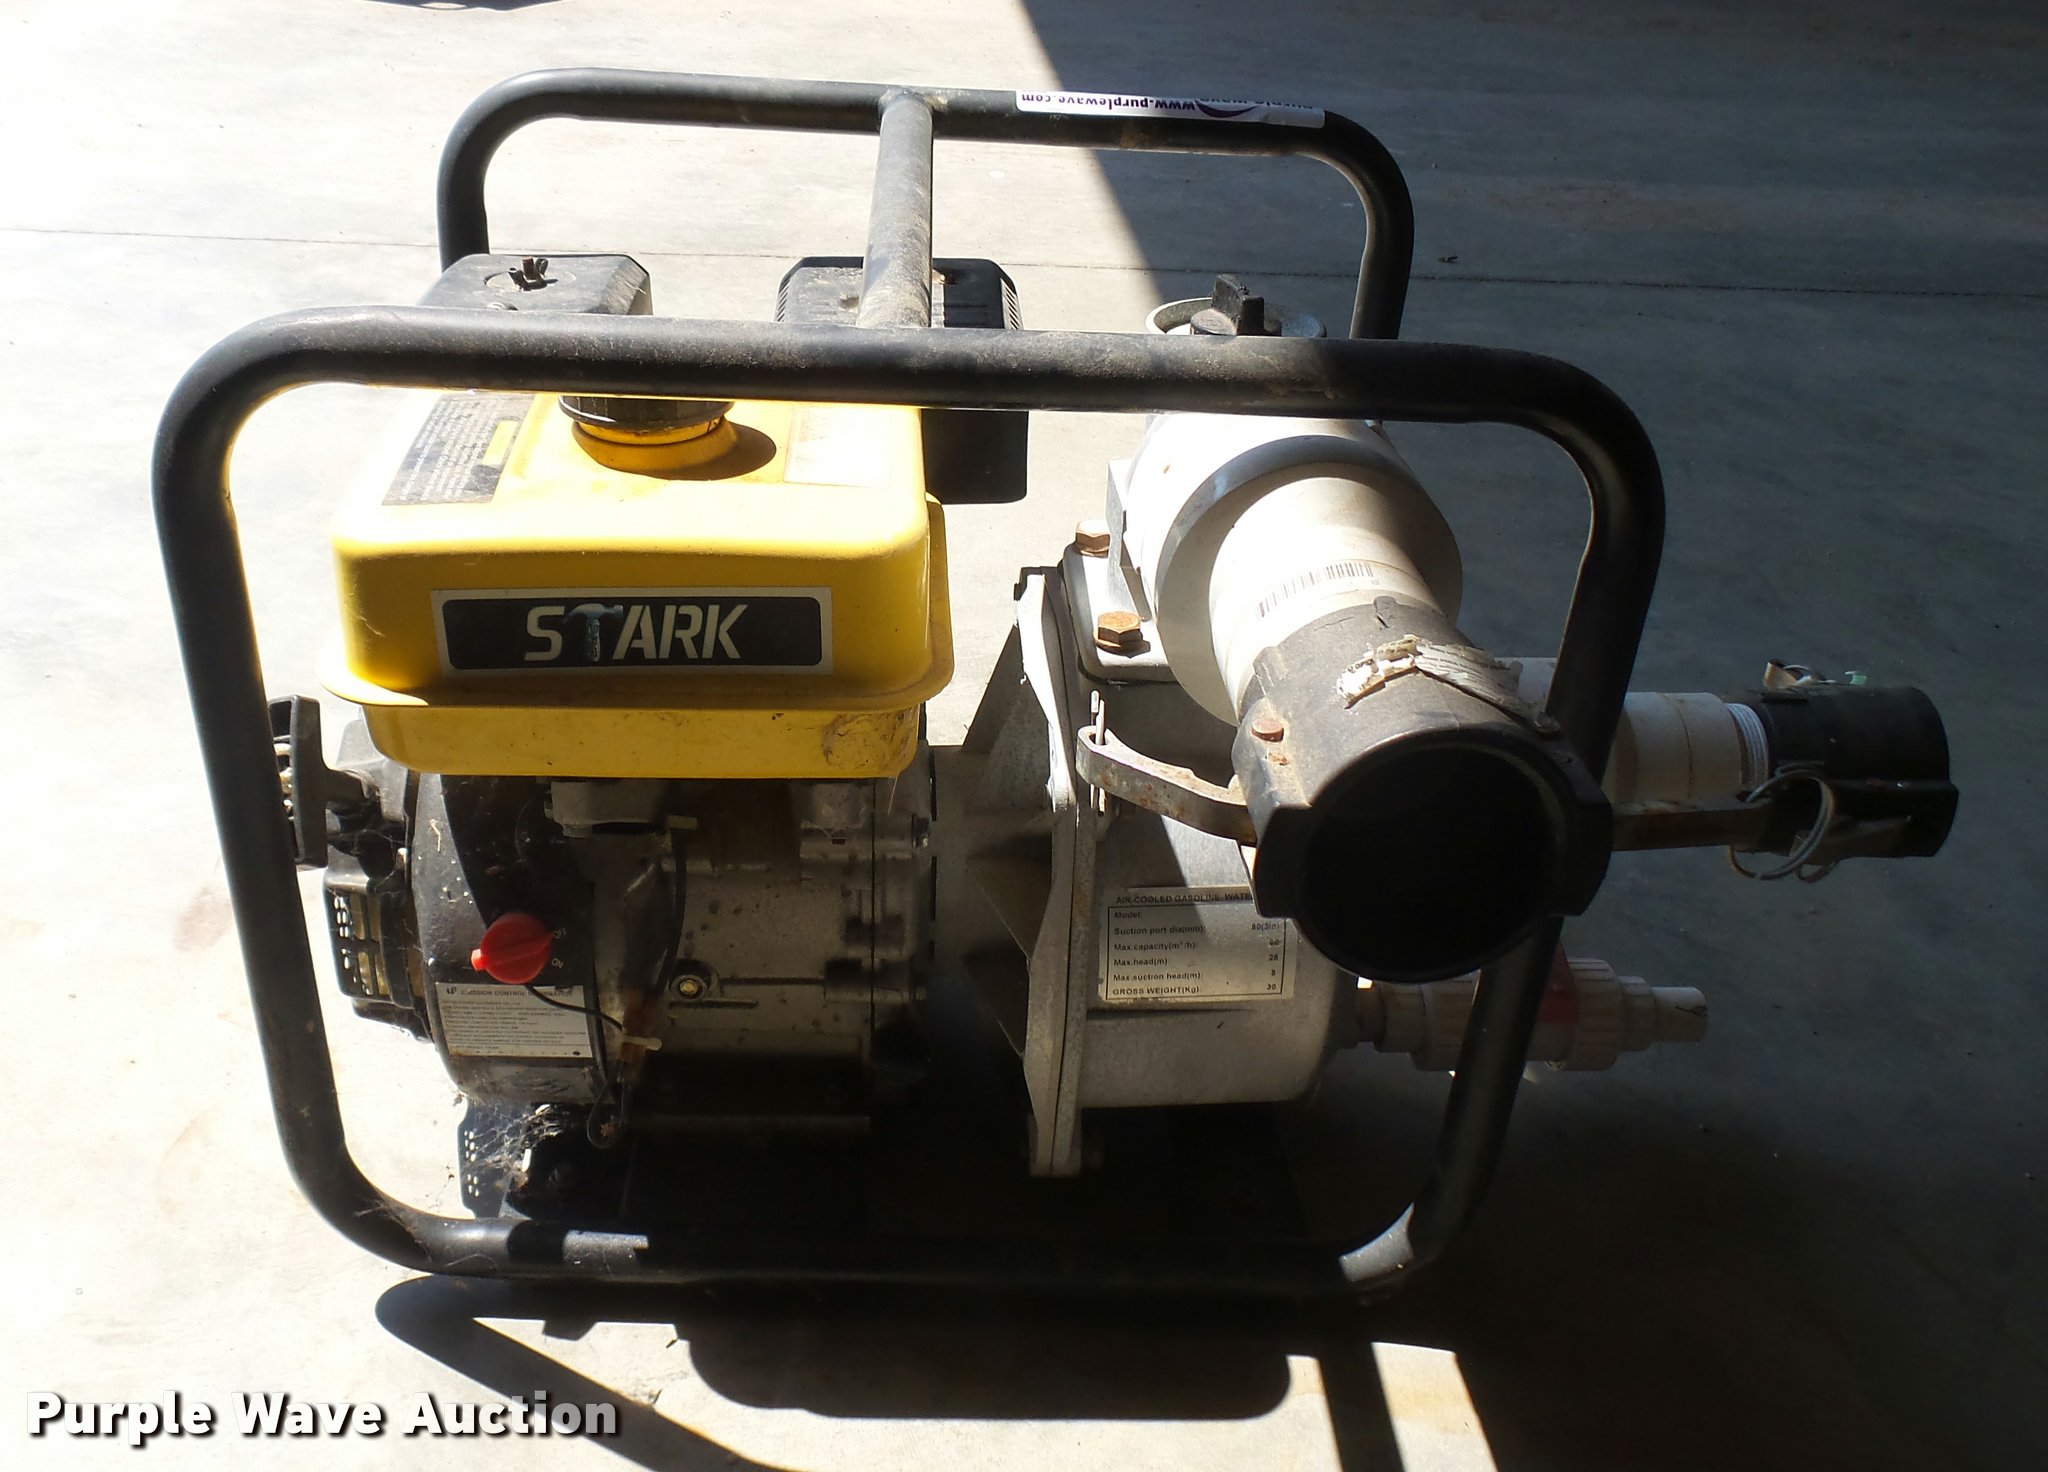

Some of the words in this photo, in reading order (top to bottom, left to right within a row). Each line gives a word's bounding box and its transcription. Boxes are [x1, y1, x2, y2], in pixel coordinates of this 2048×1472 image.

[524, 603, 748, 662] STARK
[1224, 893, 1253, 901] WATE
[1114, 927, 1147, 935] Suction
[1149, 926, 1167, 936] port
[551, 957, 564, 969] ON
[1112, 987, 1145, 995] GROSS
